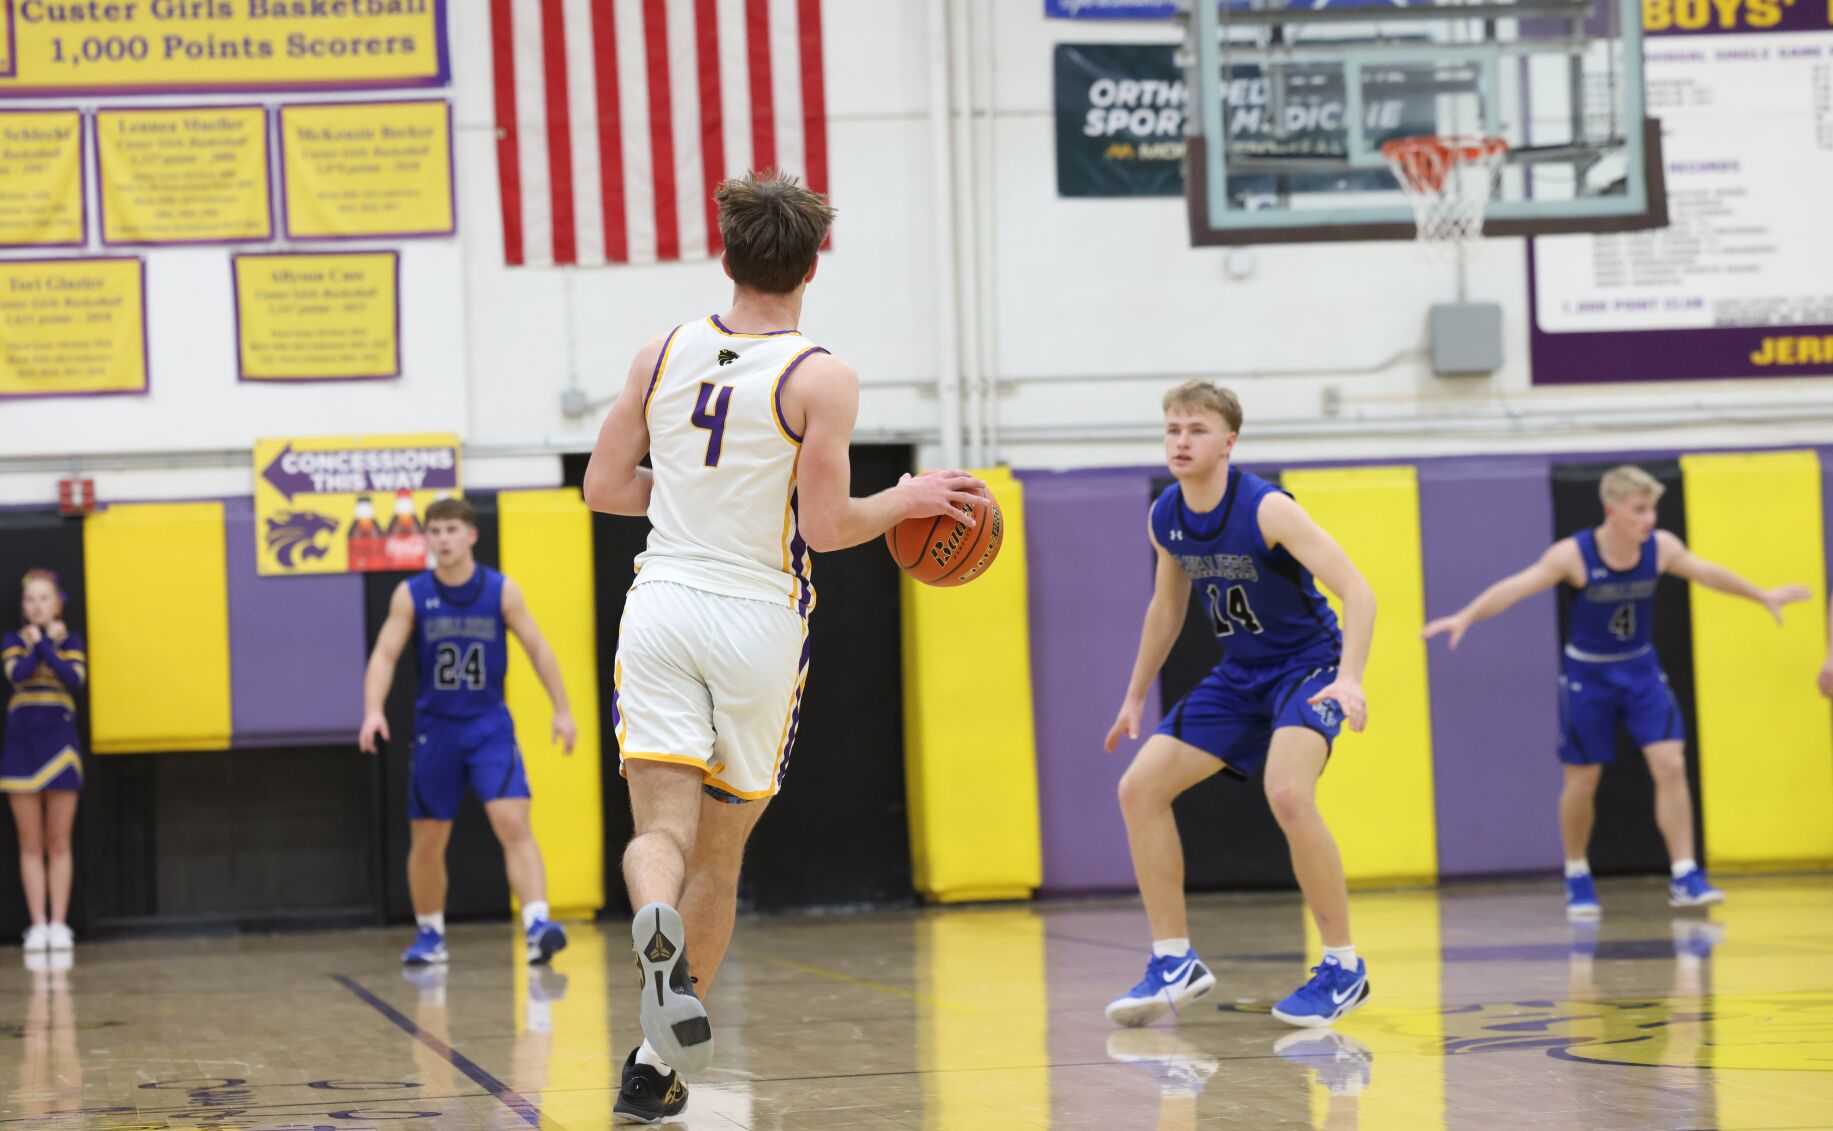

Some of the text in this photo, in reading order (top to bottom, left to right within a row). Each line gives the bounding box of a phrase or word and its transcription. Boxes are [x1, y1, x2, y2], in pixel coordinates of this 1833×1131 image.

[21, 0, 426, 22] Custer Girls Basketball
[52, 32, 416, 67] 1,000 Points Scorers
[690, 380, 735, 469] 4
[281, 449, 454, 475] CONCESSIONS
[309, 470, 428, 492] THIS WAY
[1206, 584, 1264, 637] 14
[1608, 602, 1636, 641] 4
[434, 642, 486, 690] 24
